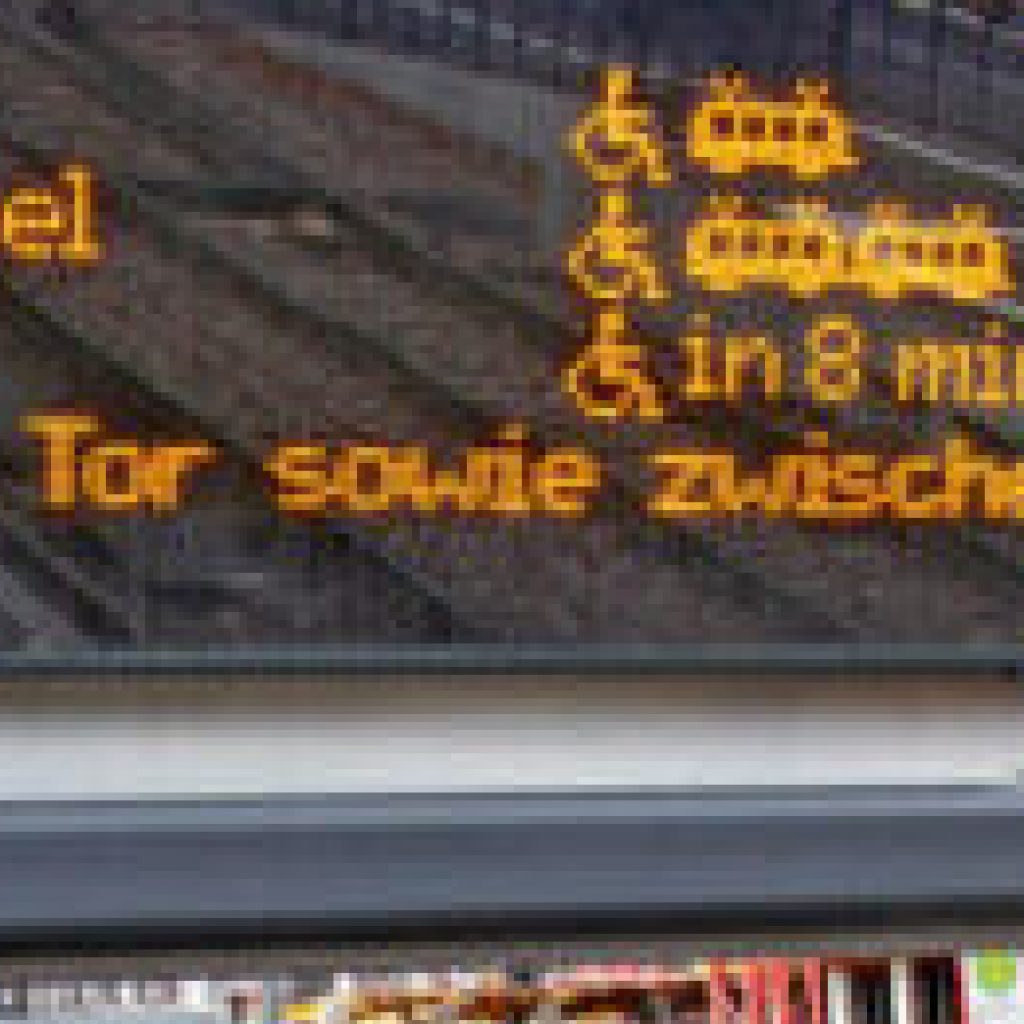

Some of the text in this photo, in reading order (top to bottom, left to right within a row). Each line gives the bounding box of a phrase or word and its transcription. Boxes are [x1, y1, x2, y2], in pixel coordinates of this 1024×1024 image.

[679, 315, 1024, 406] in 8 mi
[21, 412, 216, 514] Tor
[266, 424, 600, 518] sowie
[648, 430, 1024, 520] zwisch
